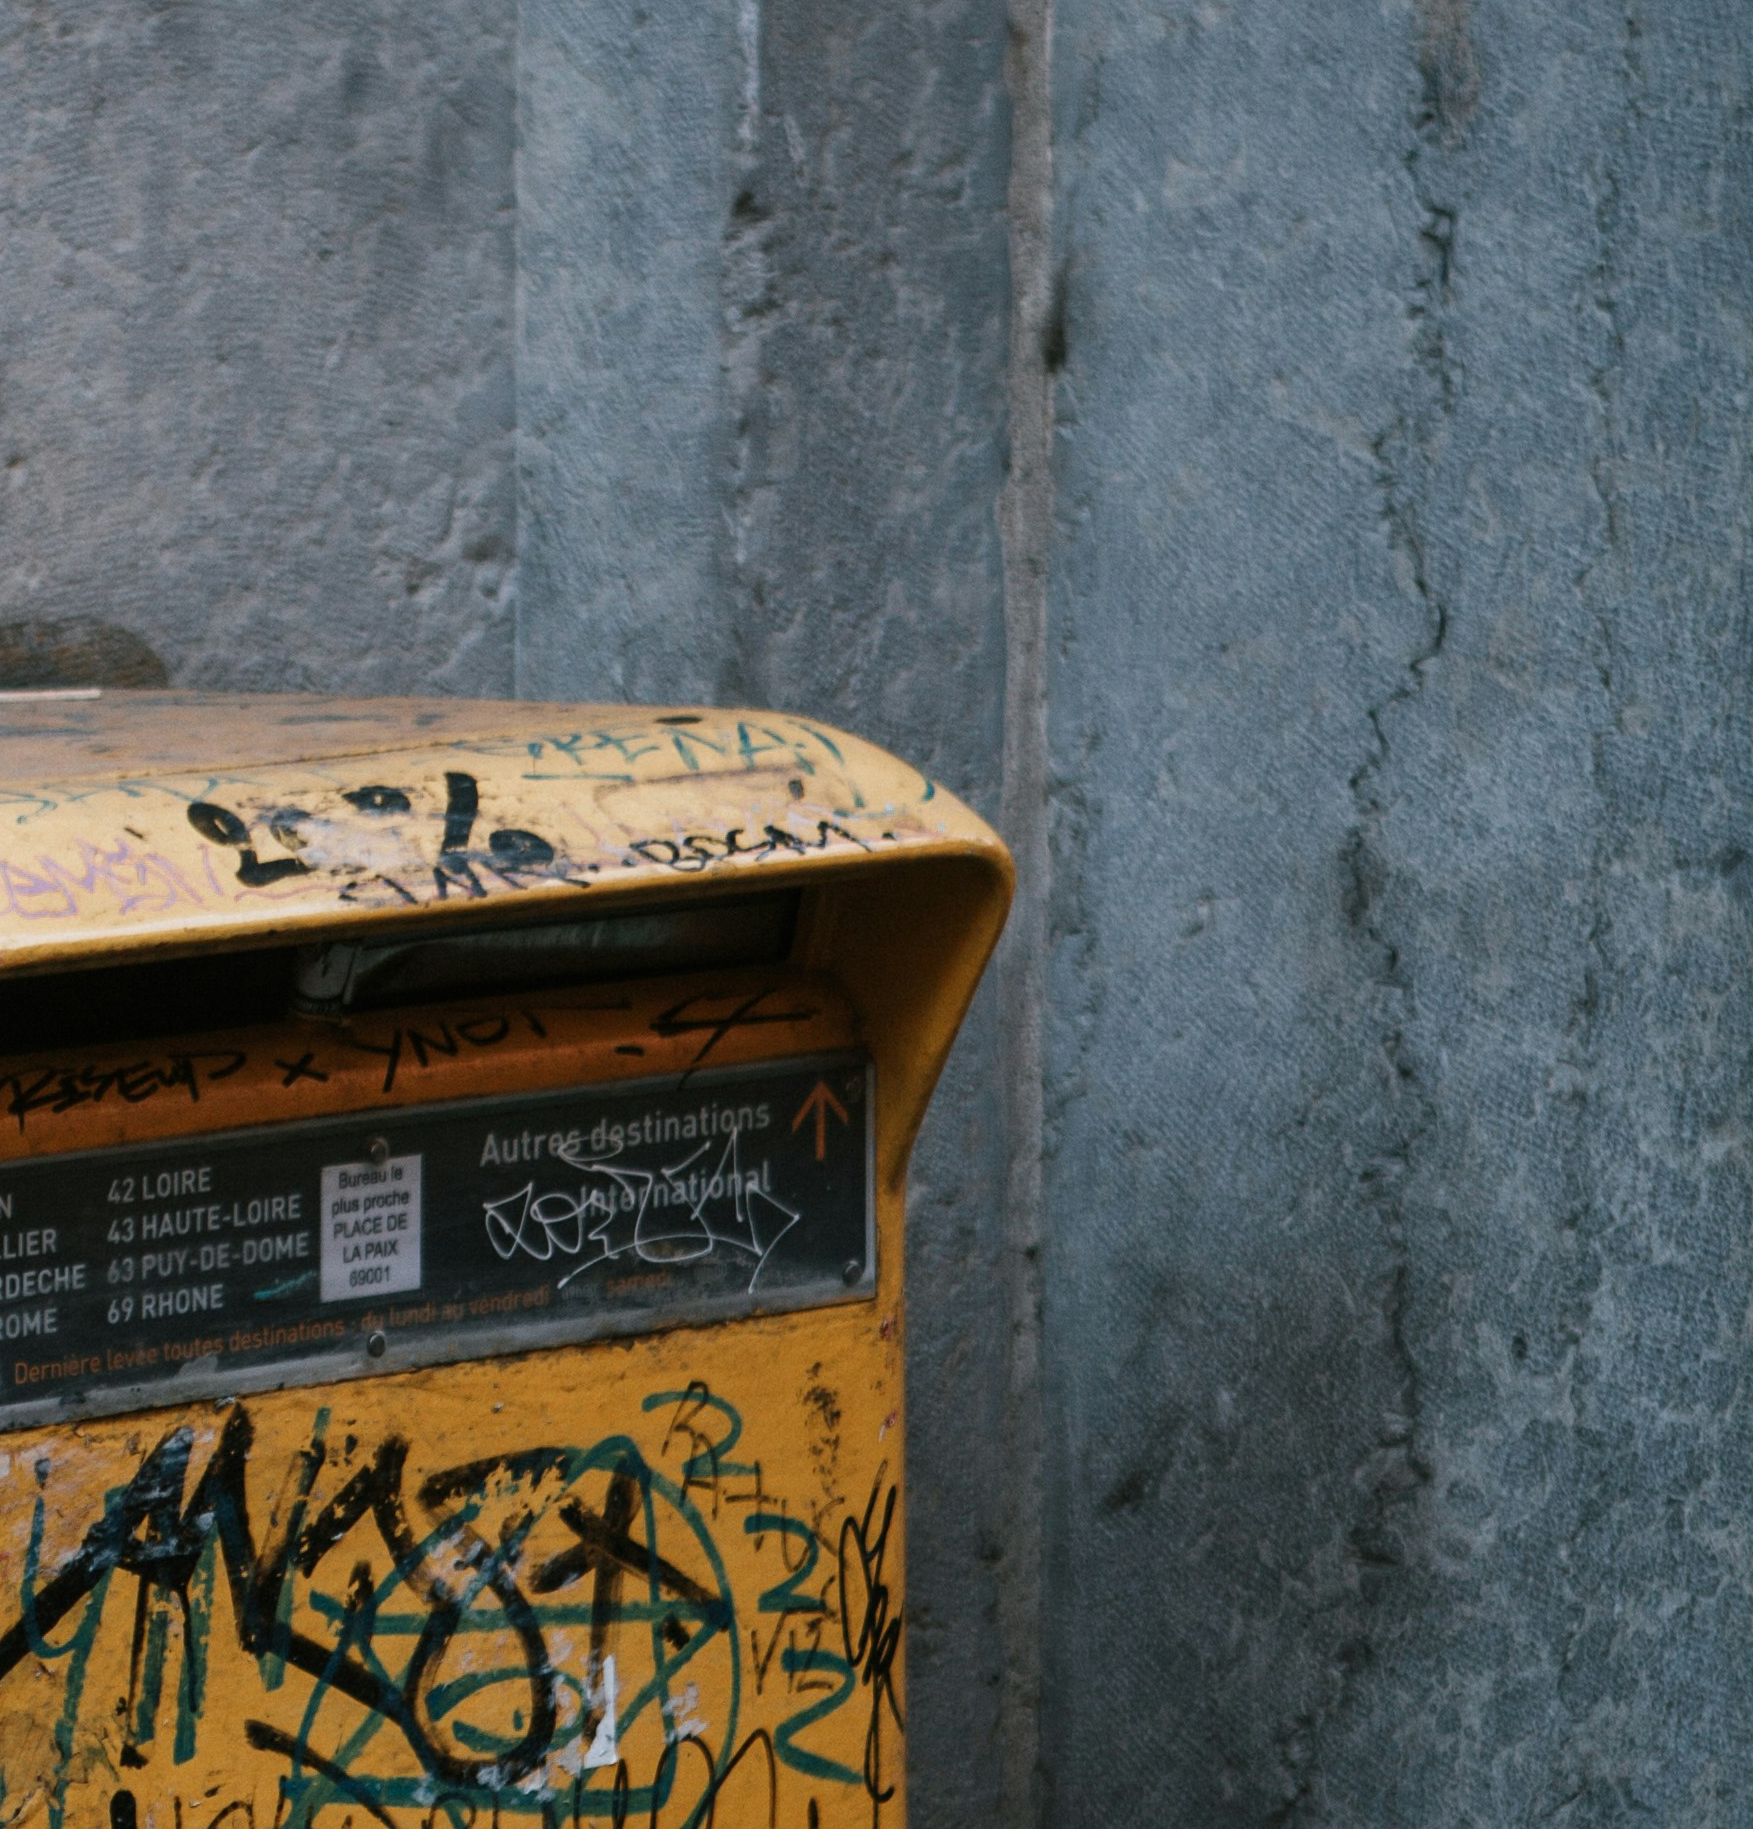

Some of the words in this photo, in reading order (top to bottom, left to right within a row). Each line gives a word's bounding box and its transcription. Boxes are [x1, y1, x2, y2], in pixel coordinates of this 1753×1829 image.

[479, 1126, 581, 1168] Autres
[591, 1103, 771, 1152] destinations
[107, 1177, 135, 1203] 42
[142, 1169, 212, 1200] LOIRE
[338, 1171, 386, 1189] Bureau
[391, 1166, 403, 1181] le
[581, 1160, 771, 1218] International
[107, 1218, 135, 1244] 43
[142, 1195, 302, 1240] HAUTE-LOIRE
[332, 1198, 359, 1218] plus
[364, 1191, 410, 1214] proche
[334, 1216, 382, 1238] PLACE
[387, 1213, 407, 1231] DE
[107, 1259, 135, 1285] 63
[142, 1233, 309, 1280] PUY-DE-DOME
[343, 1246, 361, 1263] LA
[365, 1240, 398, 1259] PAIX
[349, 1266, 390, 1287] 69001
[107, 1298, 135, 1324] 69
[142, 1285, 224, 1319] RHONE
[14, 1354, 100, 1385] Dernière
[163, 1338, 223, 1361] toutes
[229, 1320, 345, 1352] destinations
[362, 1309, 384, 1331] du
[389, 1303, 435, 1325] lundi
[470, 1284, 549, 1316] vendredi
